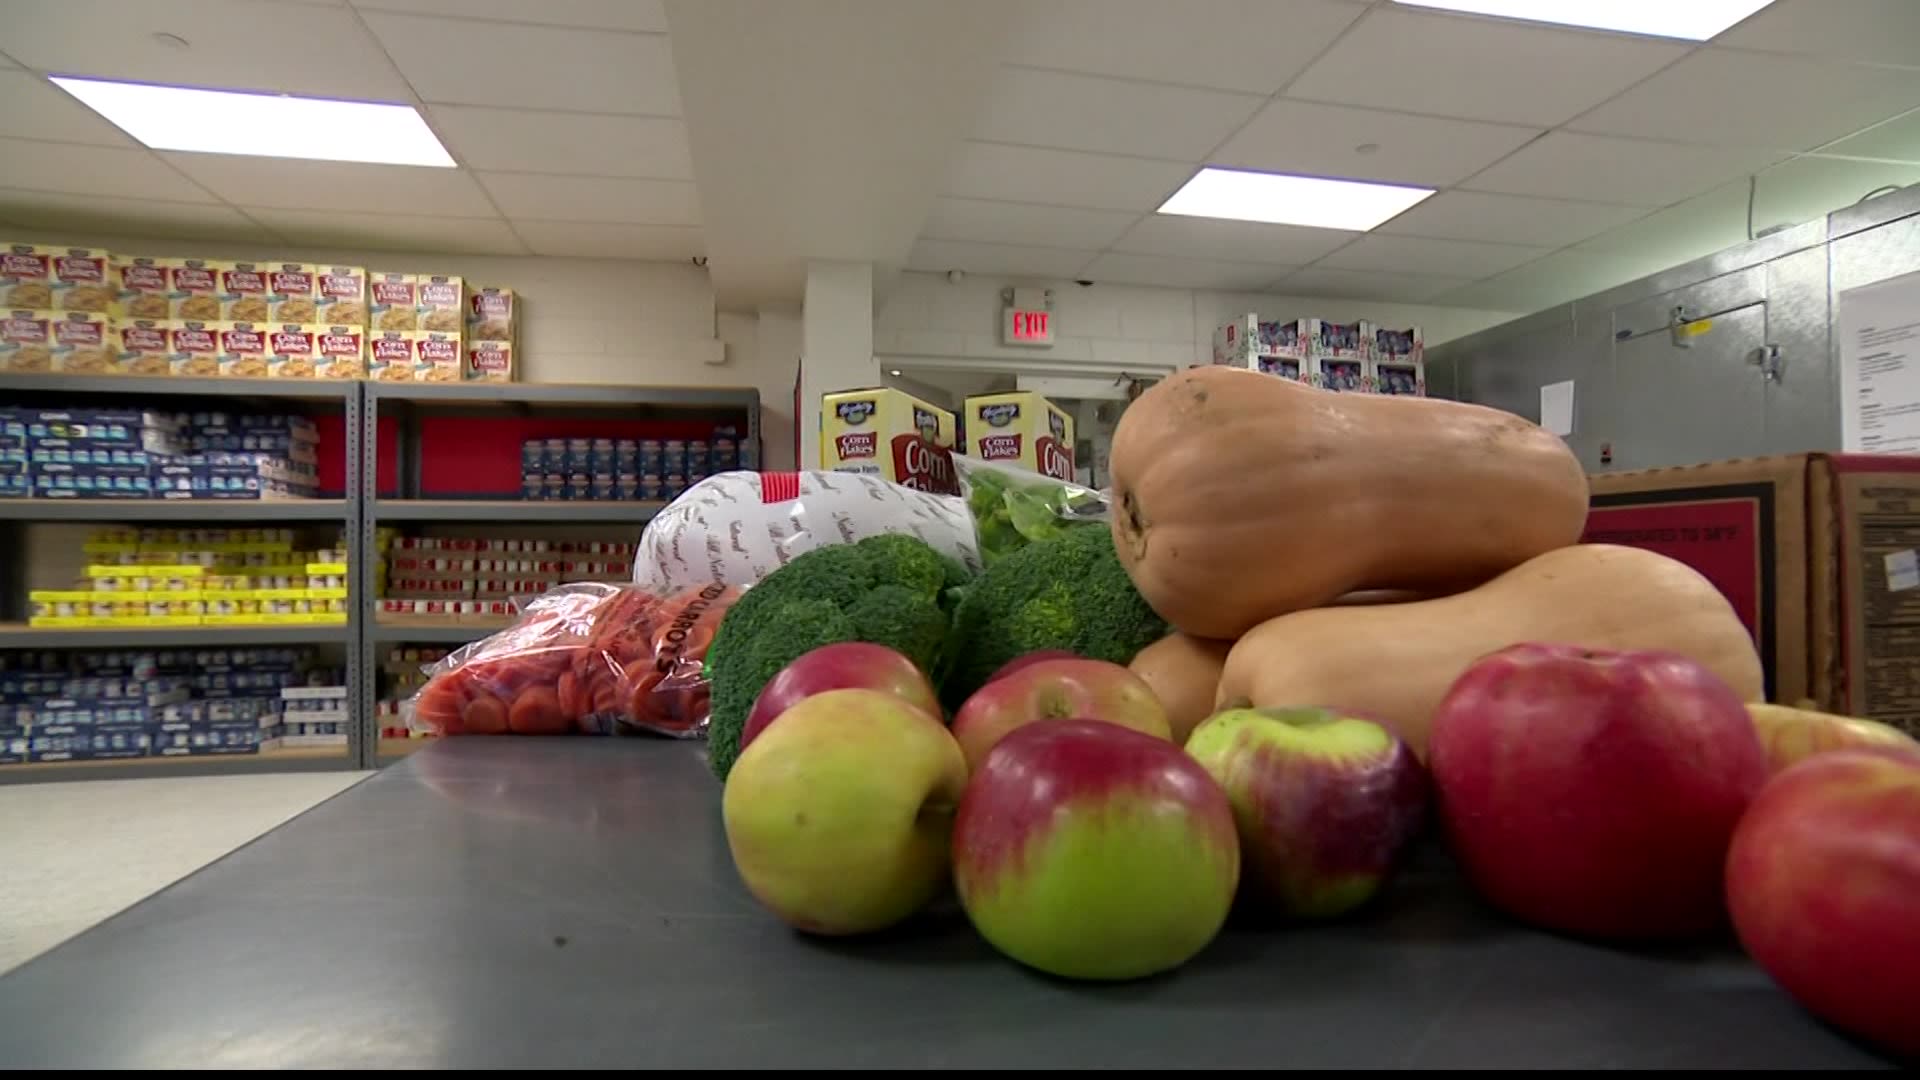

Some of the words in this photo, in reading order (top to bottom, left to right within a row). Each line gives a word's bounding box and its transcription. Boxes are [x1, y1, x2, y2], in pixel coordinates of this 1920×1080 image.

[1013, 311, 1048, 337] EXIT
[842, 436, 870, 447] Corn
[985, 439, 1014, 449] Corn
[841, 444, 873, 458] Flakes
[983, 446, 1018, 458] Flakes
[906, 440, 947, 480] Corn
[1045, 443, 1071, 481] Corn
